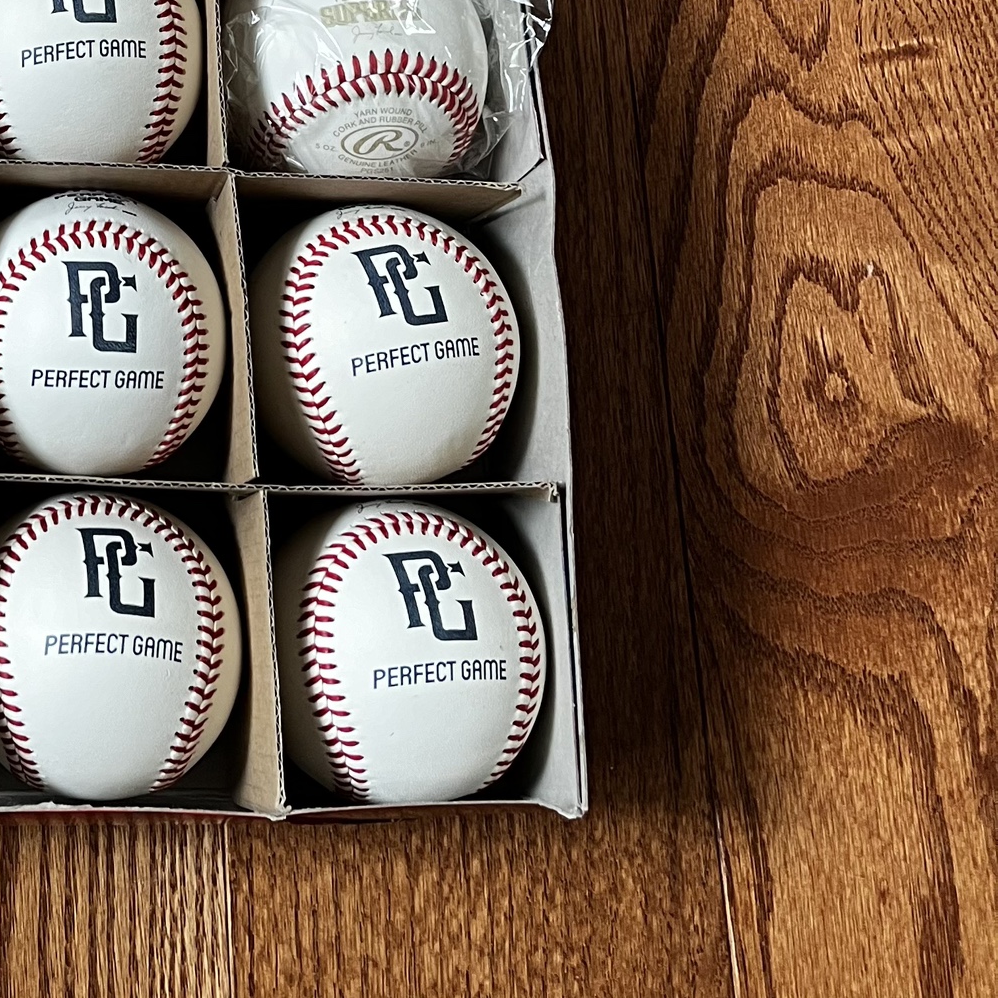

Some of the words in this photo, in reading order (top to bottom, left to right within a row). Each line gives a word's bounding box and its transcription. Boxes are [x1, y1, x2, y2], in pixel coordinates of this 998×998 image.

[21, 39, 96, 68] PERFECT
[99, 39, 147, 59] GAME
[354, 107, 378, 119] YARN
[380, 107, 413, 116] WOUND
[332, 122, 358, 138] CORK
[358, 116, 377, 126] AND
[379, 115, 414, 126] RUBBER
[337, 154, 377, 168] GENUINE
[378, 149, 418, 167] LEATHER
[351, 342, 431, 377] PERFECT
[434, 337, 480, 360] GAME
[31, 369, 112, 389] PERFECT
[114, 369, 165, 389] GAME
[44, 632, 129, 656] PERFECT
[132, 635, 184, 663] GAME
[373, 660, 457, 690] PERFECT
[460, 659, 508, 682] GAME
